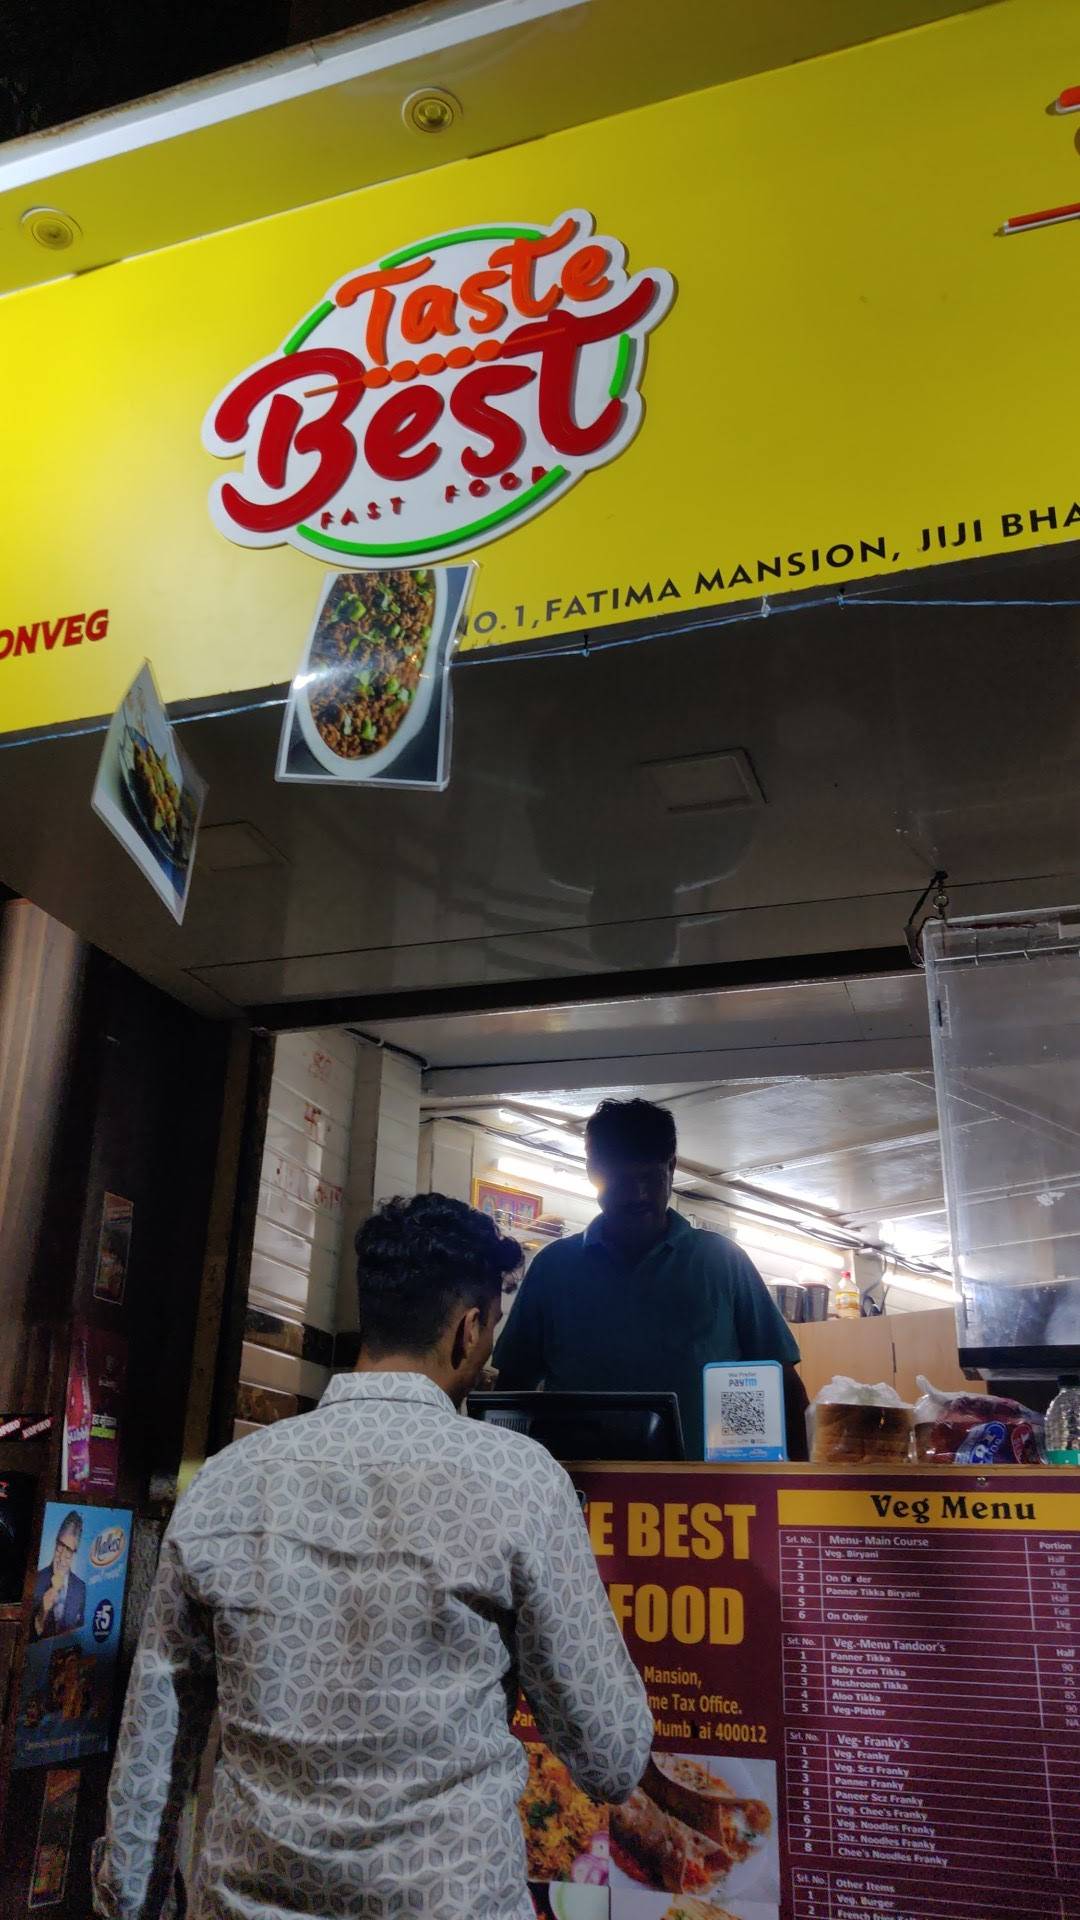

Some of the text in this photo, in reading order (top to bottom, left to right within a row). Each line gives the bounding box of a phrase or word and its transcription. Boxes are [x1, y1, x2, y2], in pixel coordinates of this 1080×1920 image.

[335, 217, 612, 366] Taste
[214, 276, 656, 533] Best
[320, 496, 404, 529] FAST
[694, 535, 900, 595] MANSION,
[919, 518, 984, 551] JIJI
[870, 1494, 1036, 1524] Veg Menu
[627, 1502, 756, 1560] BEST
[865, 1536, 891, 1546] Main
[893, 1536, 929, 1547] Course
[797, 1548, 803, 1557] 1
[797, 1560, 804, 1569] 2
[797, 1573, 804, 1582] 3
[797, 1585, 805, 1594] 4
[798, 1598, 805, 1607] 5
[609, 1583, 744, 1645] FOOD
[798, 1610, 806, 1619] 6
[800, 1664, 808, 1673] 2
[645, 1667, 702, 1687] Mansion,
[800, 1677, 808, 1686] 3
[800, 1690, 808, 1699] 4
[672, 1695, 696, 1710] Tax
[700, 1696, 743, 1714] Office.
[801, 1703, 809, 1712] 5
[715, 1725, 768, 1743] 400012
[802, 1760, 809, 1769] 2
[802, 1773, 809, 1782] 3
[802, 1787, 810, 1796] 4
[803, 1800, 810, 1809] 5
[804, 1829, 811, 1838] 7
